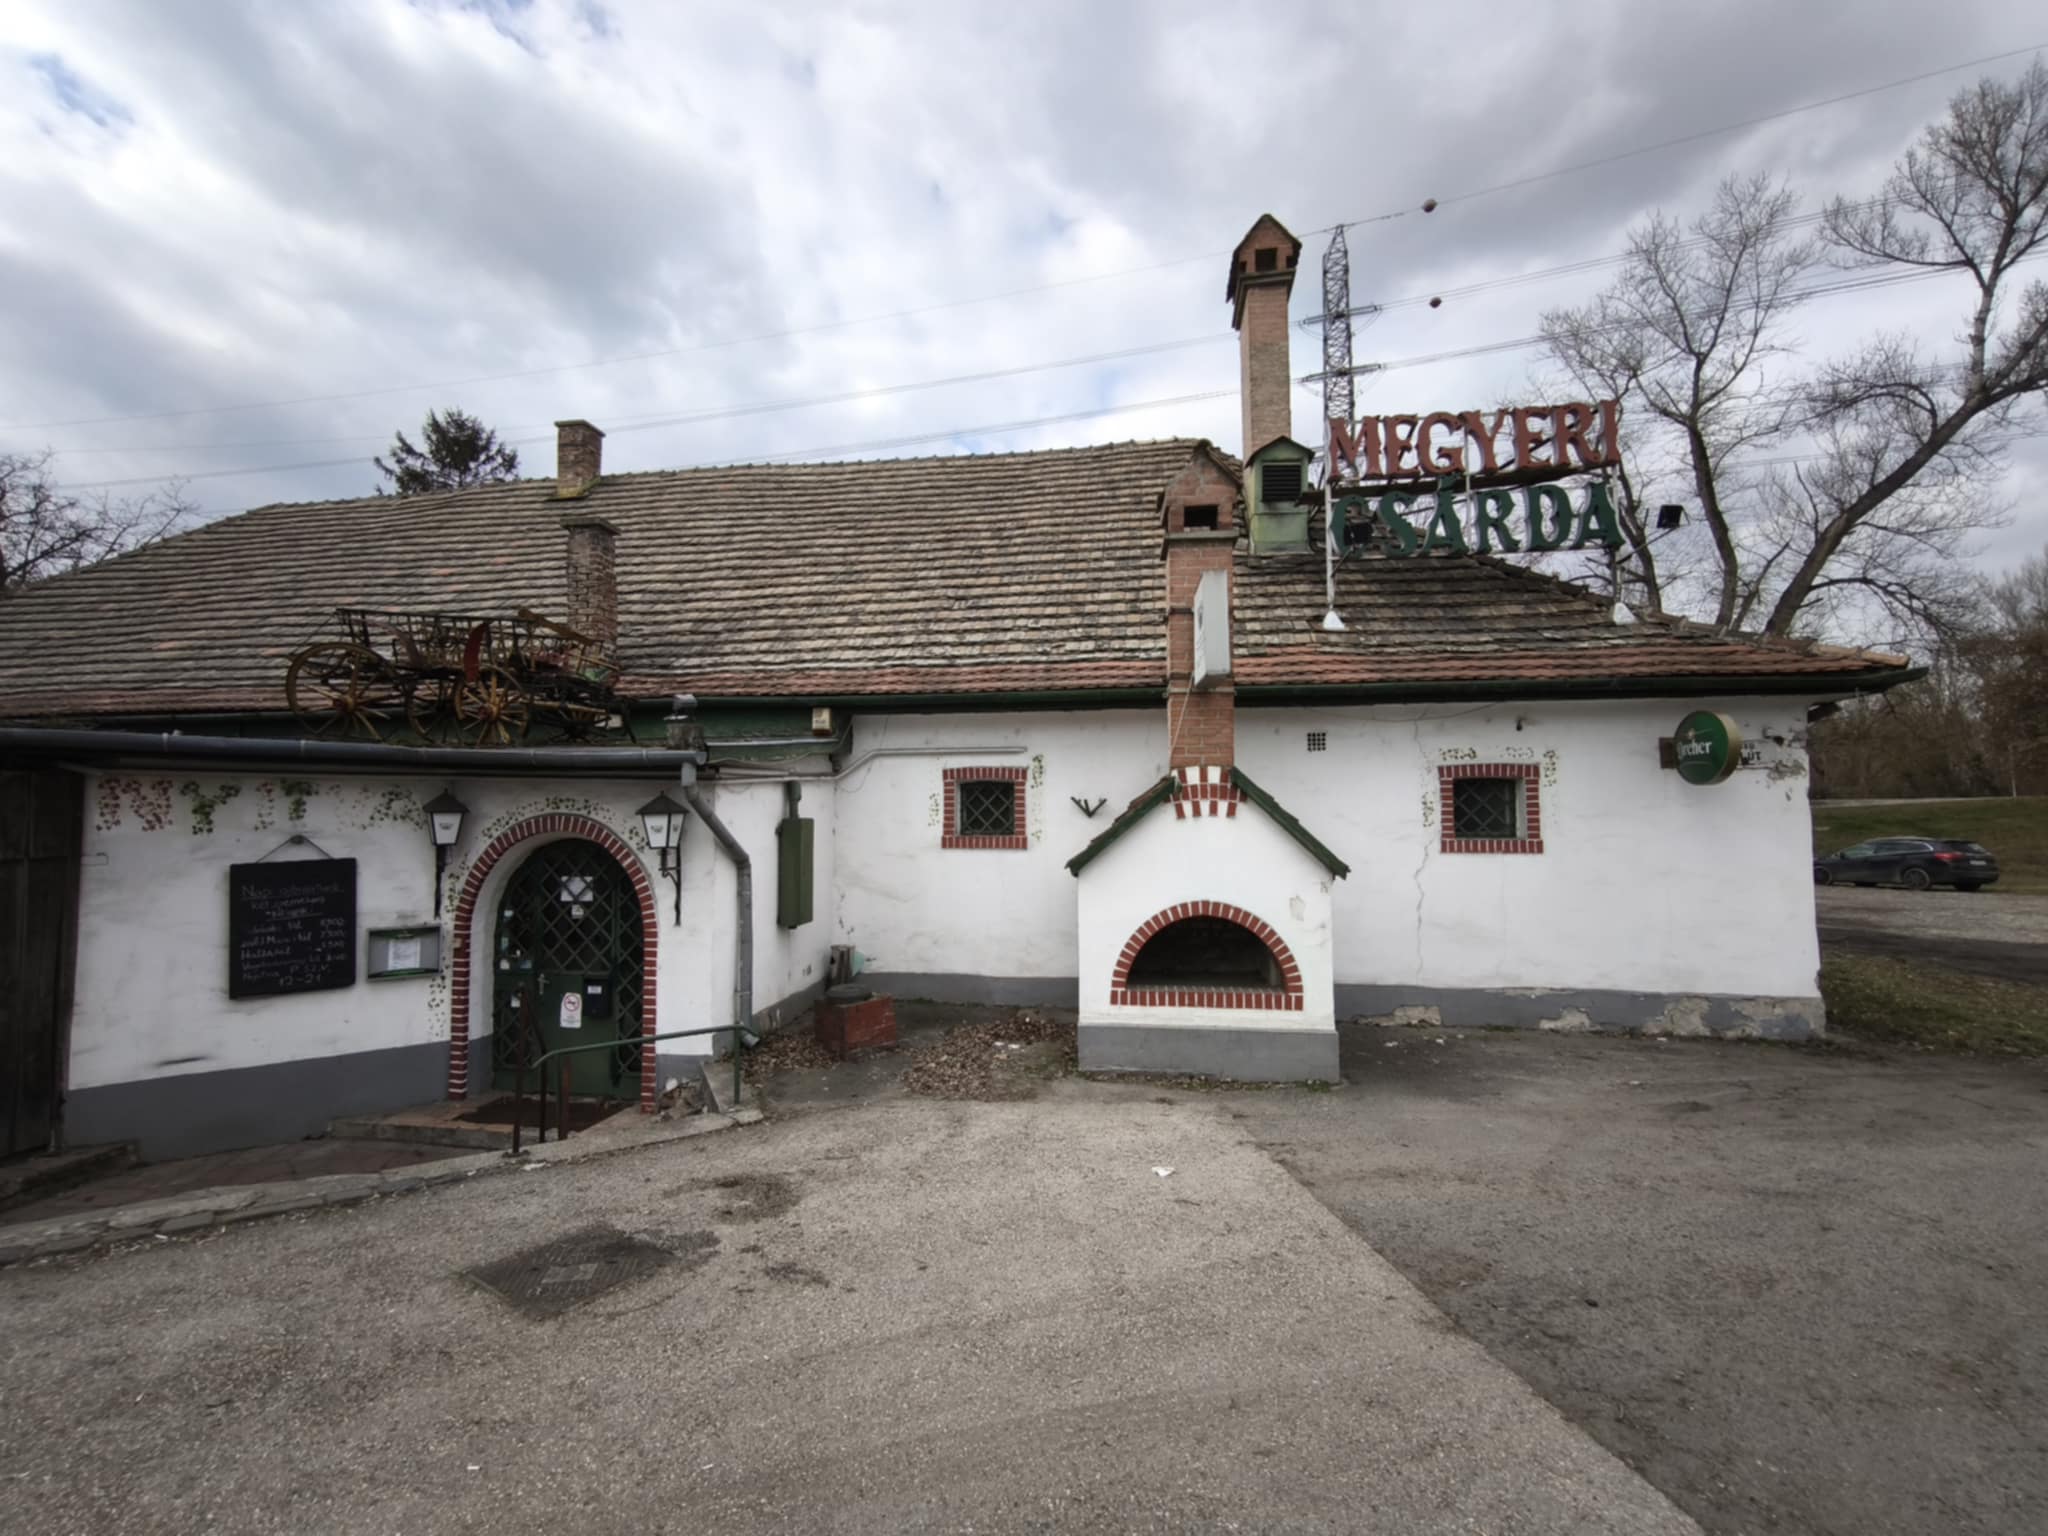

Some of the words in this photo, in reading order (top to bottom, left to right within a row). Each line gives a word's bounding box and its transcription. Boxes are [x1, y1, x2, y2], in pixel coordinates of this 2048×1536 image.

[1328, 400, 1620, 482] MEGYERI
[1329, 475, 1624, 562] CSÁRDA
[1676, 738, 1713, 760] Dreher
